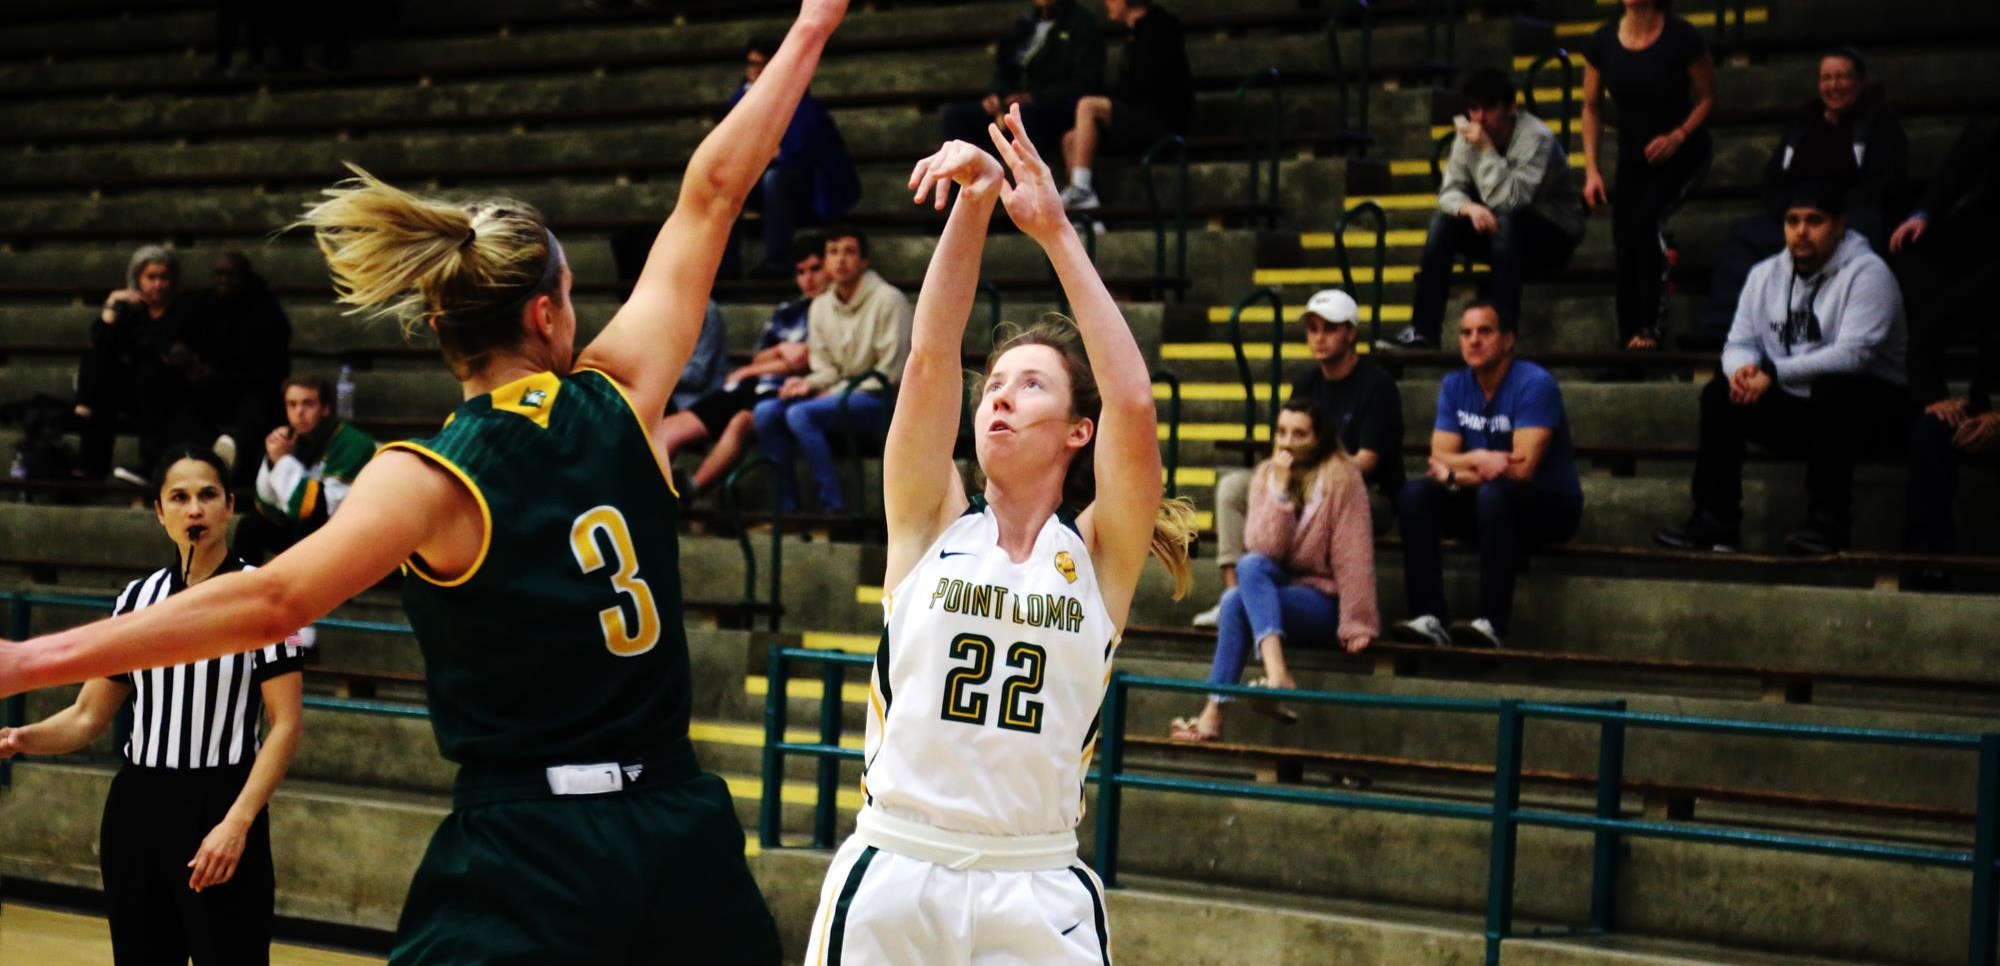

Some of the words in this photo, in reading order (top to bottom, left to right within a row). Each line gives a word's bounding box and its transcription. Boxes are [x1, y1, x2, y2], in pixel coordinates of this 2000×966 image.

[569, 504, 661, 657] 3
[929, 577, 1008, 620] POINT
[1013, 593, 1085, 633] LOMA
[940, 632, 1047, 734] 22
